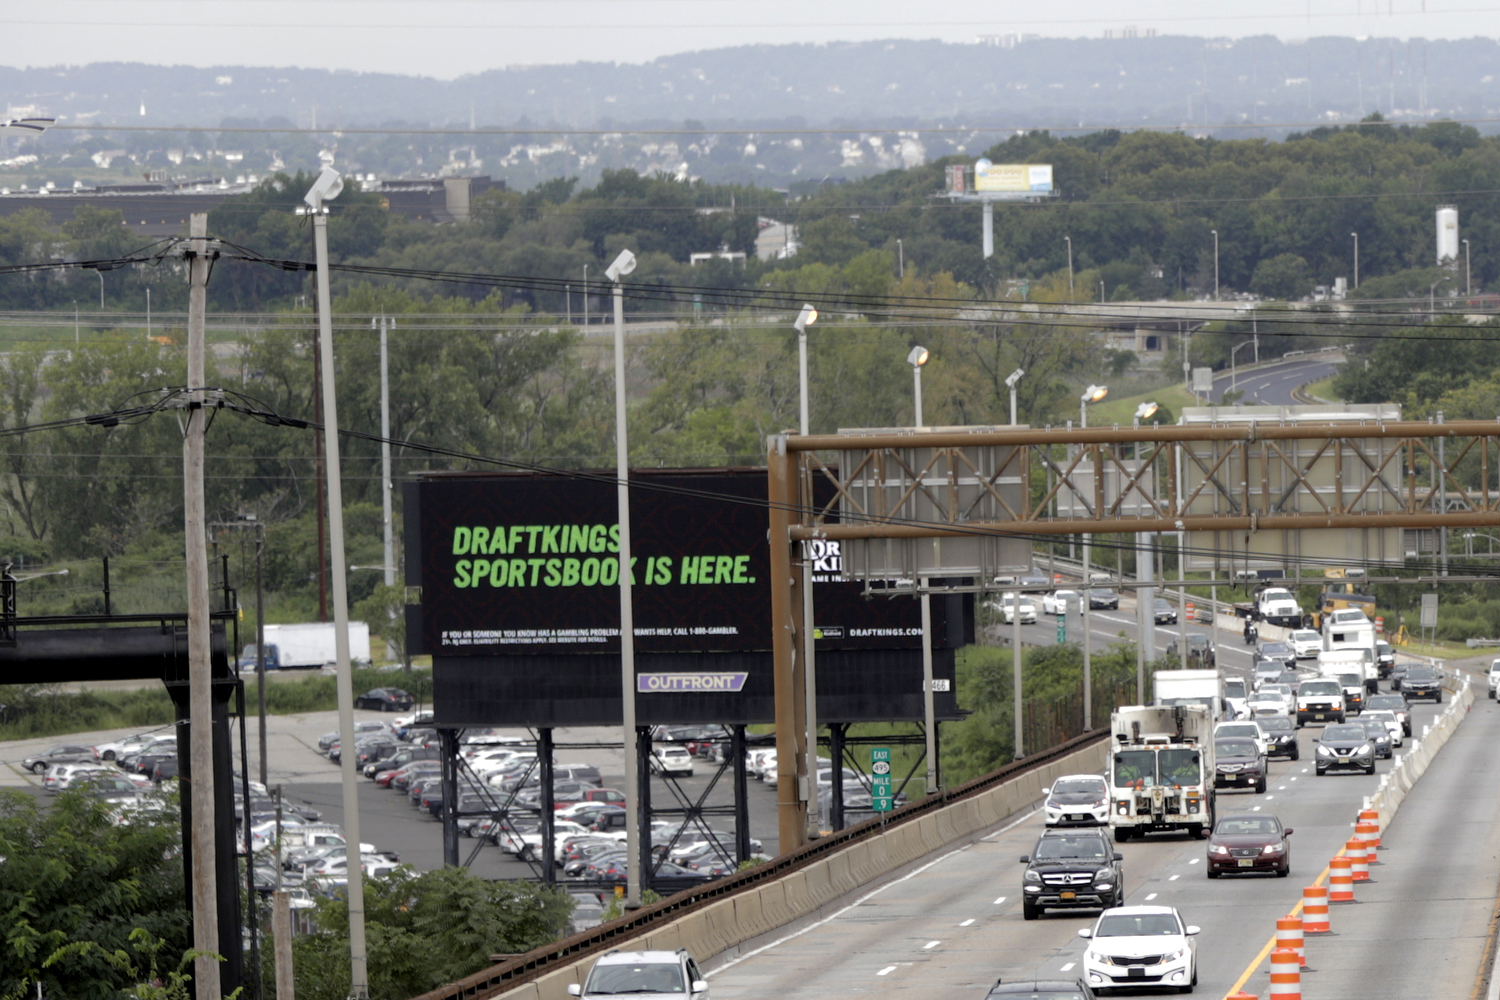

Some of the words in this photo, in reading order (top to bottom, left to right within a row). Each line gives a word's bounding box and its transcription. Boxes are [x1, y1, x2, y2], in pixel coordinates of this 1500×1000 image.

[644, 556, 673, 585] IS
[680, 555, 756, 584] HERE.
[557, 628, 589, 637] GAMBLING
[673, 627, 688, 635] CALL
[648, 675, 735, 690] OUTFRONT
[931, 681, 946, 690] 466
[873, 751, 888, 760] EAST
[874, 763, 889, 773] 495
[873, 777, 889, 786] MILE
[878, 786, 885, 796] 0
